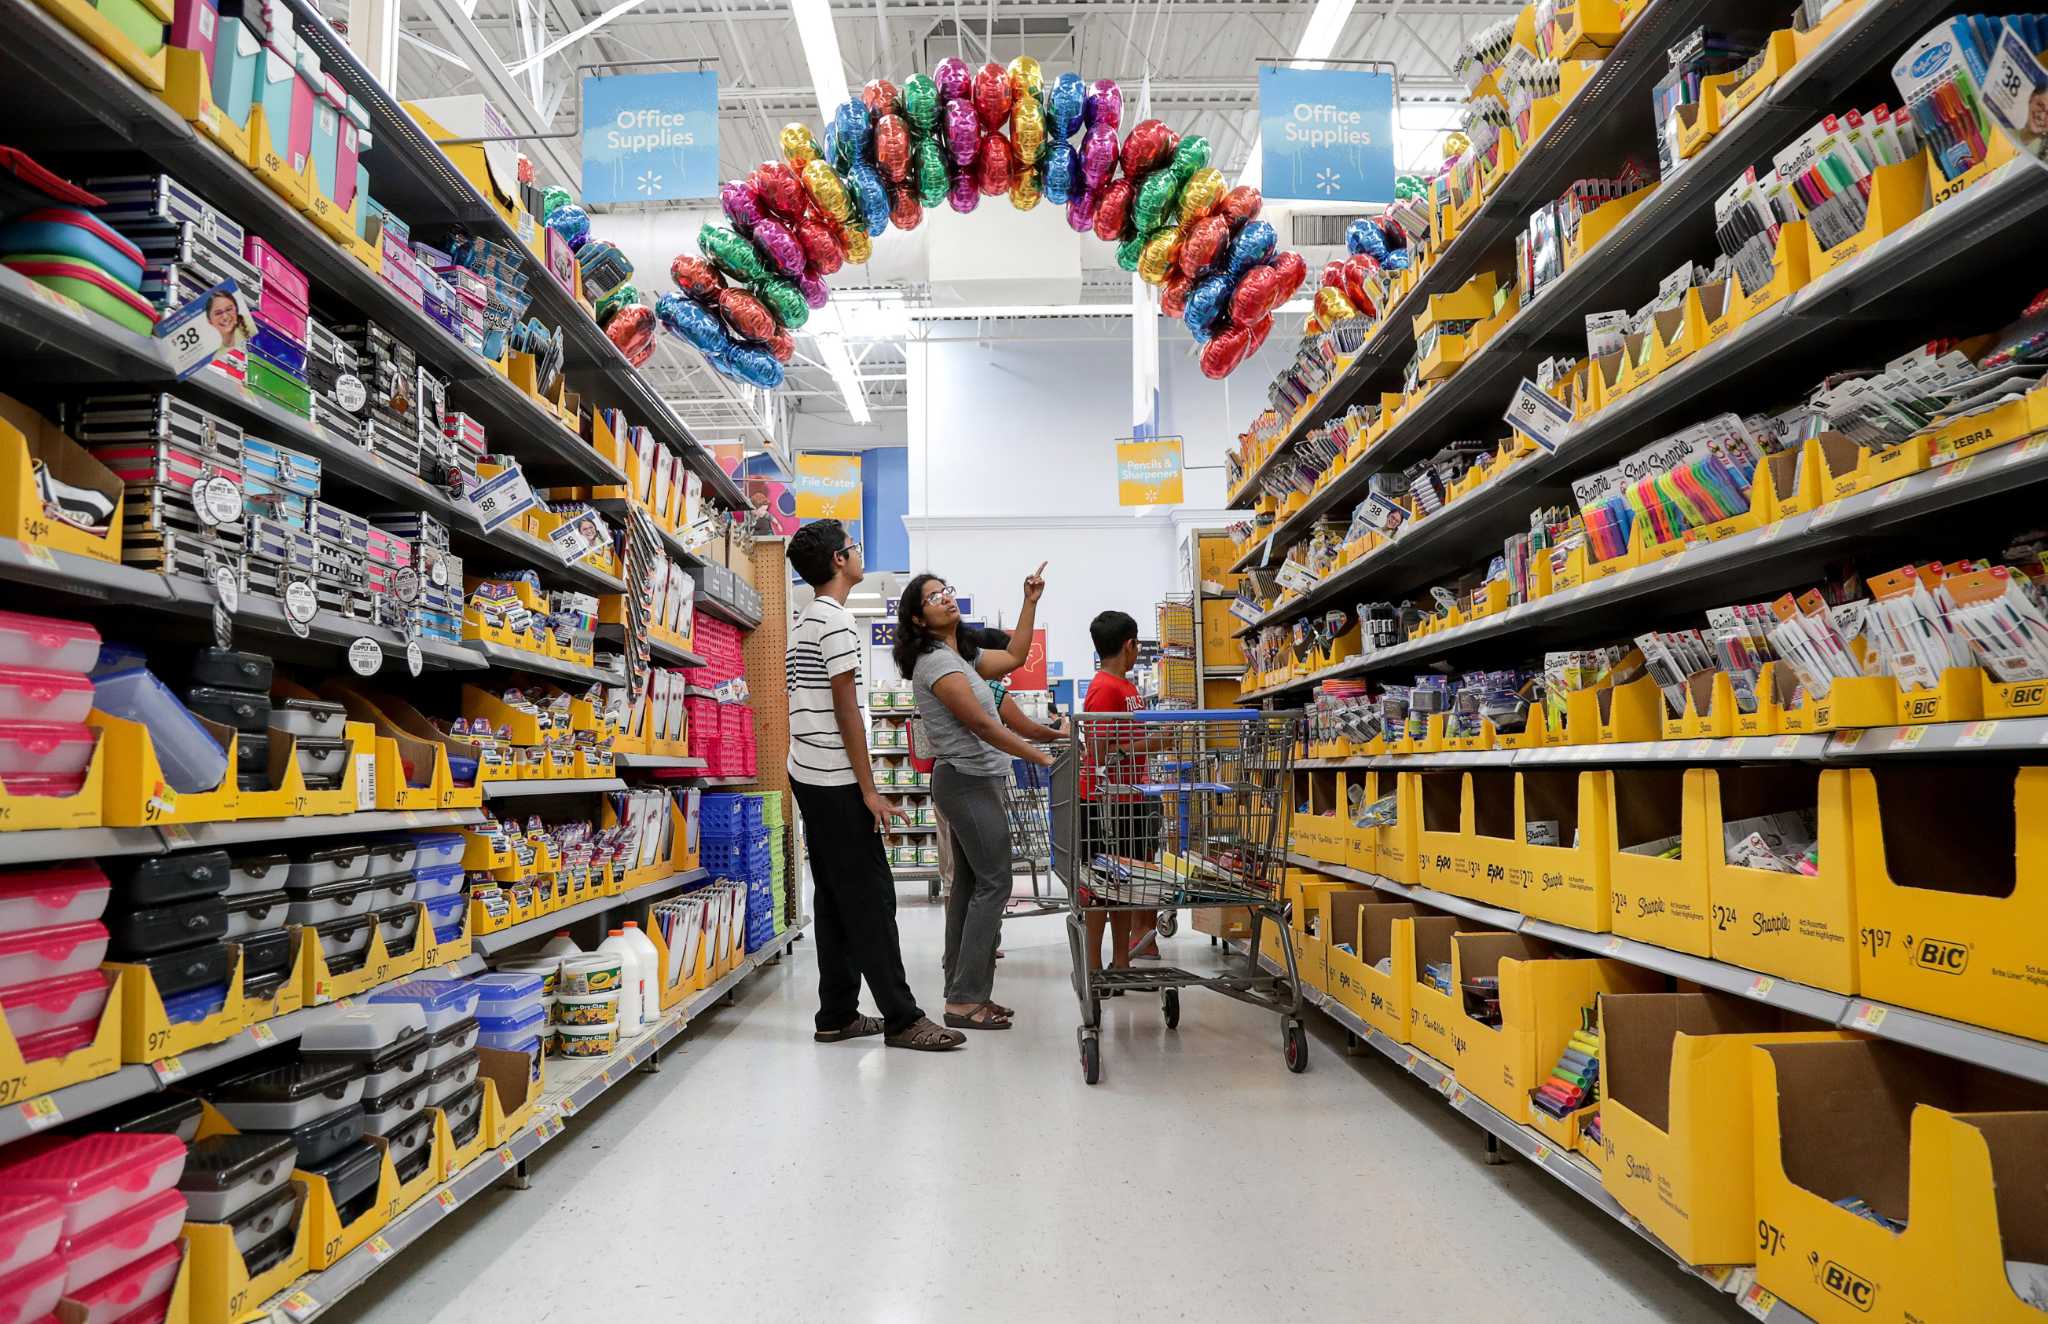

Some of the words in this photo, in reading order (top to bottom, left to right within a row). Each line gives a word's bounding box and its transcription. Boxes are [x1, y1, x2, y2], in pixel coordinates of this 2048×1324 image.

[617, 109, 685, 129] Office
[1294, 103, 1361, 125] Office
[607, 129, 694, 153] Supplies
[1285, 122, 1372, 149] Supplies
[1953, 428, 1994, 450] ZEBRA
[1648, 438, 1694, 473] Sharpie
[1624, 459, 1649, 482] Shar
[1575, 474, 1612, 505] Sharpie
[1637, 896, 1666, 918] Sharpie
[1712, 904, 1737, 931] $224
[1751, 912, 1791, 937] Sharpie
[1860, 926, 1892, 958] $197
[426, 947, 440, 965] 97¢
[148, 1029, 171, 1051] 97¢
[0, 1075, 27, 1101] 97¢
[1758, 1219, 1787, 1257] 97¢
